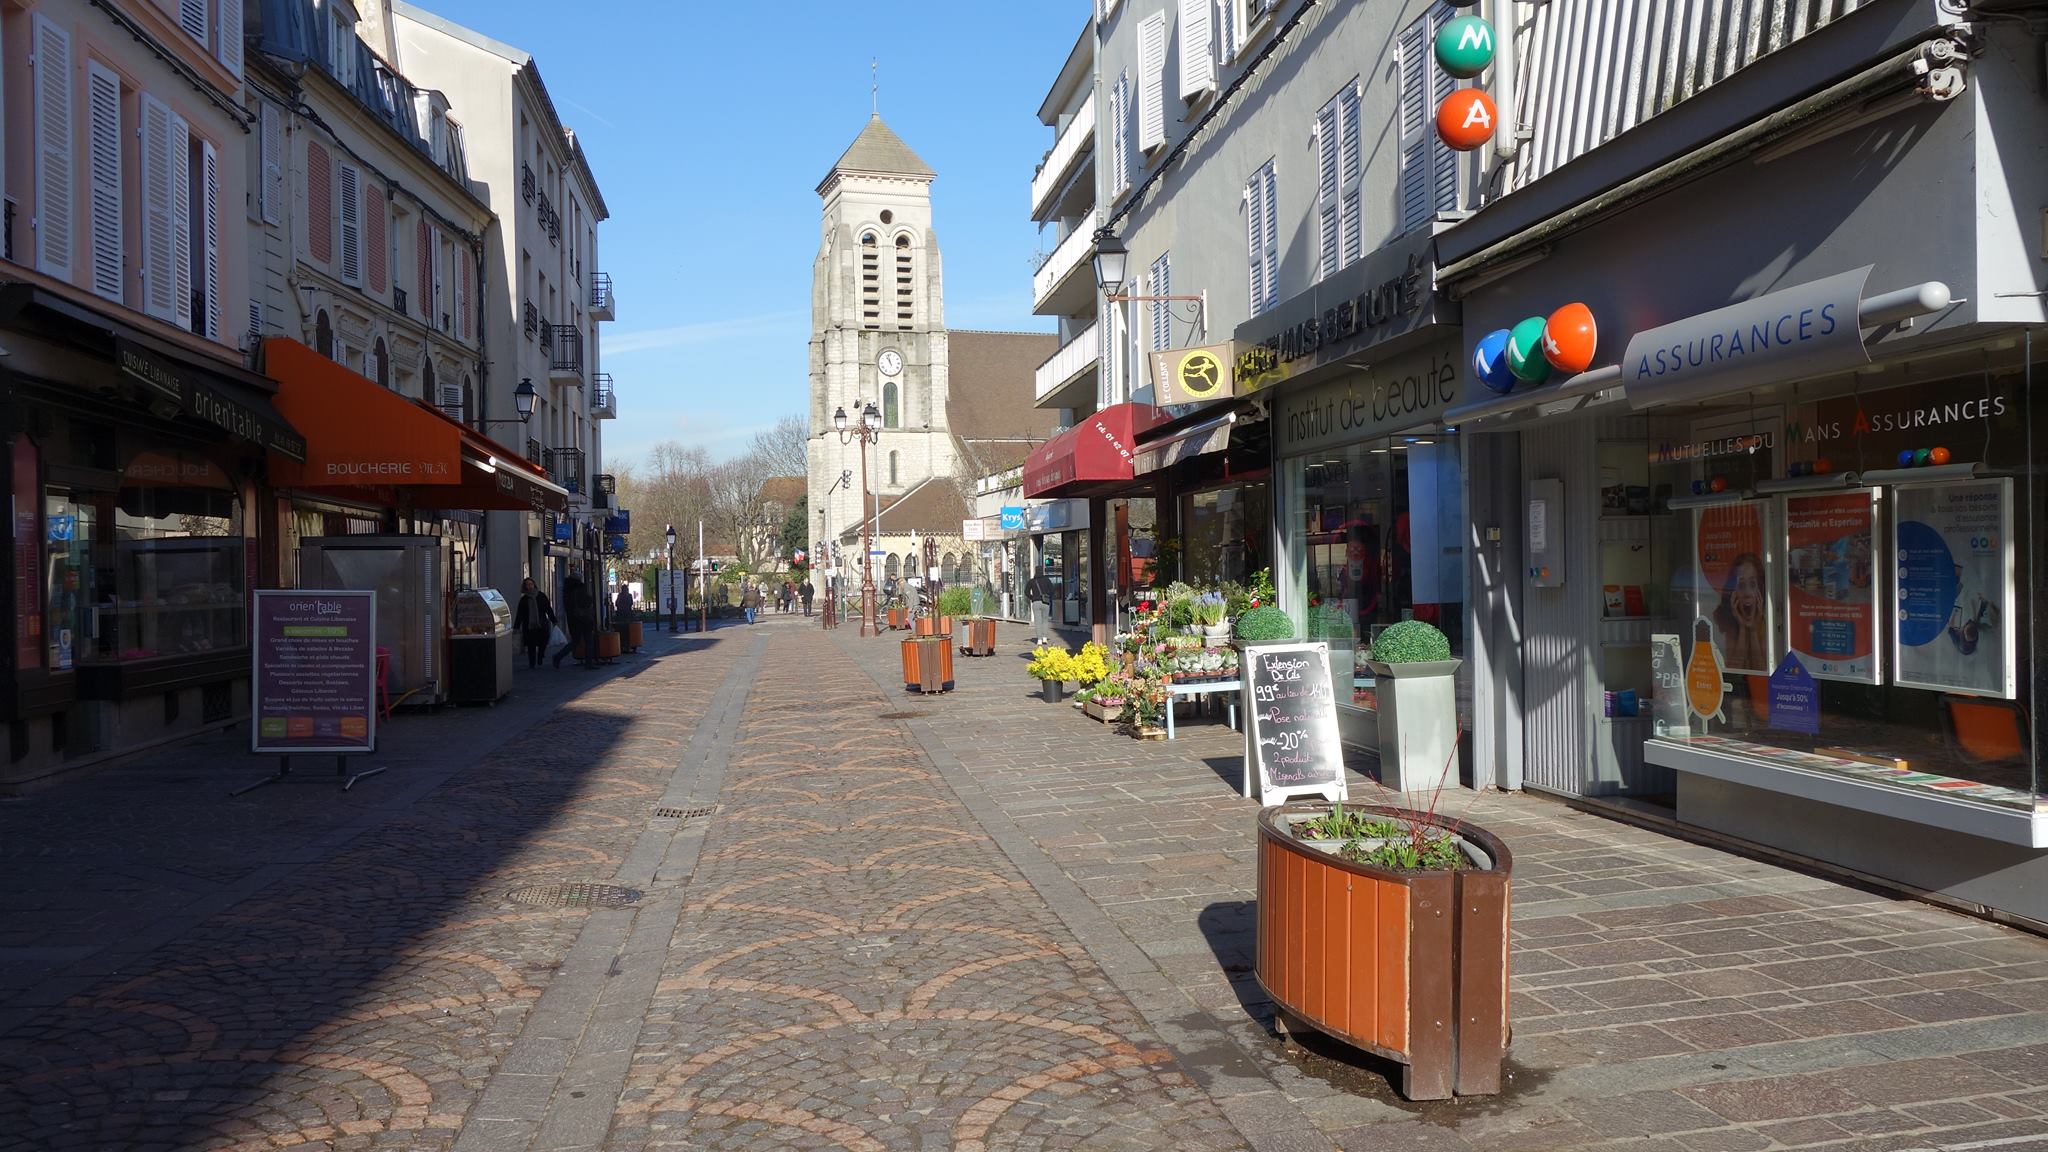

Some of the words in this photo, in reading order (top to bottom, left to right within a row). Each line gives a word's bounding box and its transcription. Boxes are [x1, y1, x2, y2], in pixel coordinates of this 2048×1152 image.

[1458, 24, 1491, 50] M
[1462, 99, 1491, 128] A
[1637, 303, 1836, 379] ASSURANCES
[1287, 397, 1335, 444] institut
[1340, 376, 1365, 429] de
[1372, 352, 1455, 421] beauté
[1658, 436, 1744, 461] MUTUELLES
[1753, 432, 1775, 450] DU
[1786, 422, 1841, 443] MANS
[1851, 396, 2005, 436] ASSURANCES
[1105, 433, 1114, 442] 01
[327, 462, 411, 475] BOUCHERIE
[1003, 513, 1021, 524] Krys
[289, 600, 342, 615] orien'table
[1263, 654, 1310, 670] Extension
[1271, 670, 1285, 680] De
[1256, 684, 1279, 701] 99€
[1270, 707, 1291, 724] Pose
